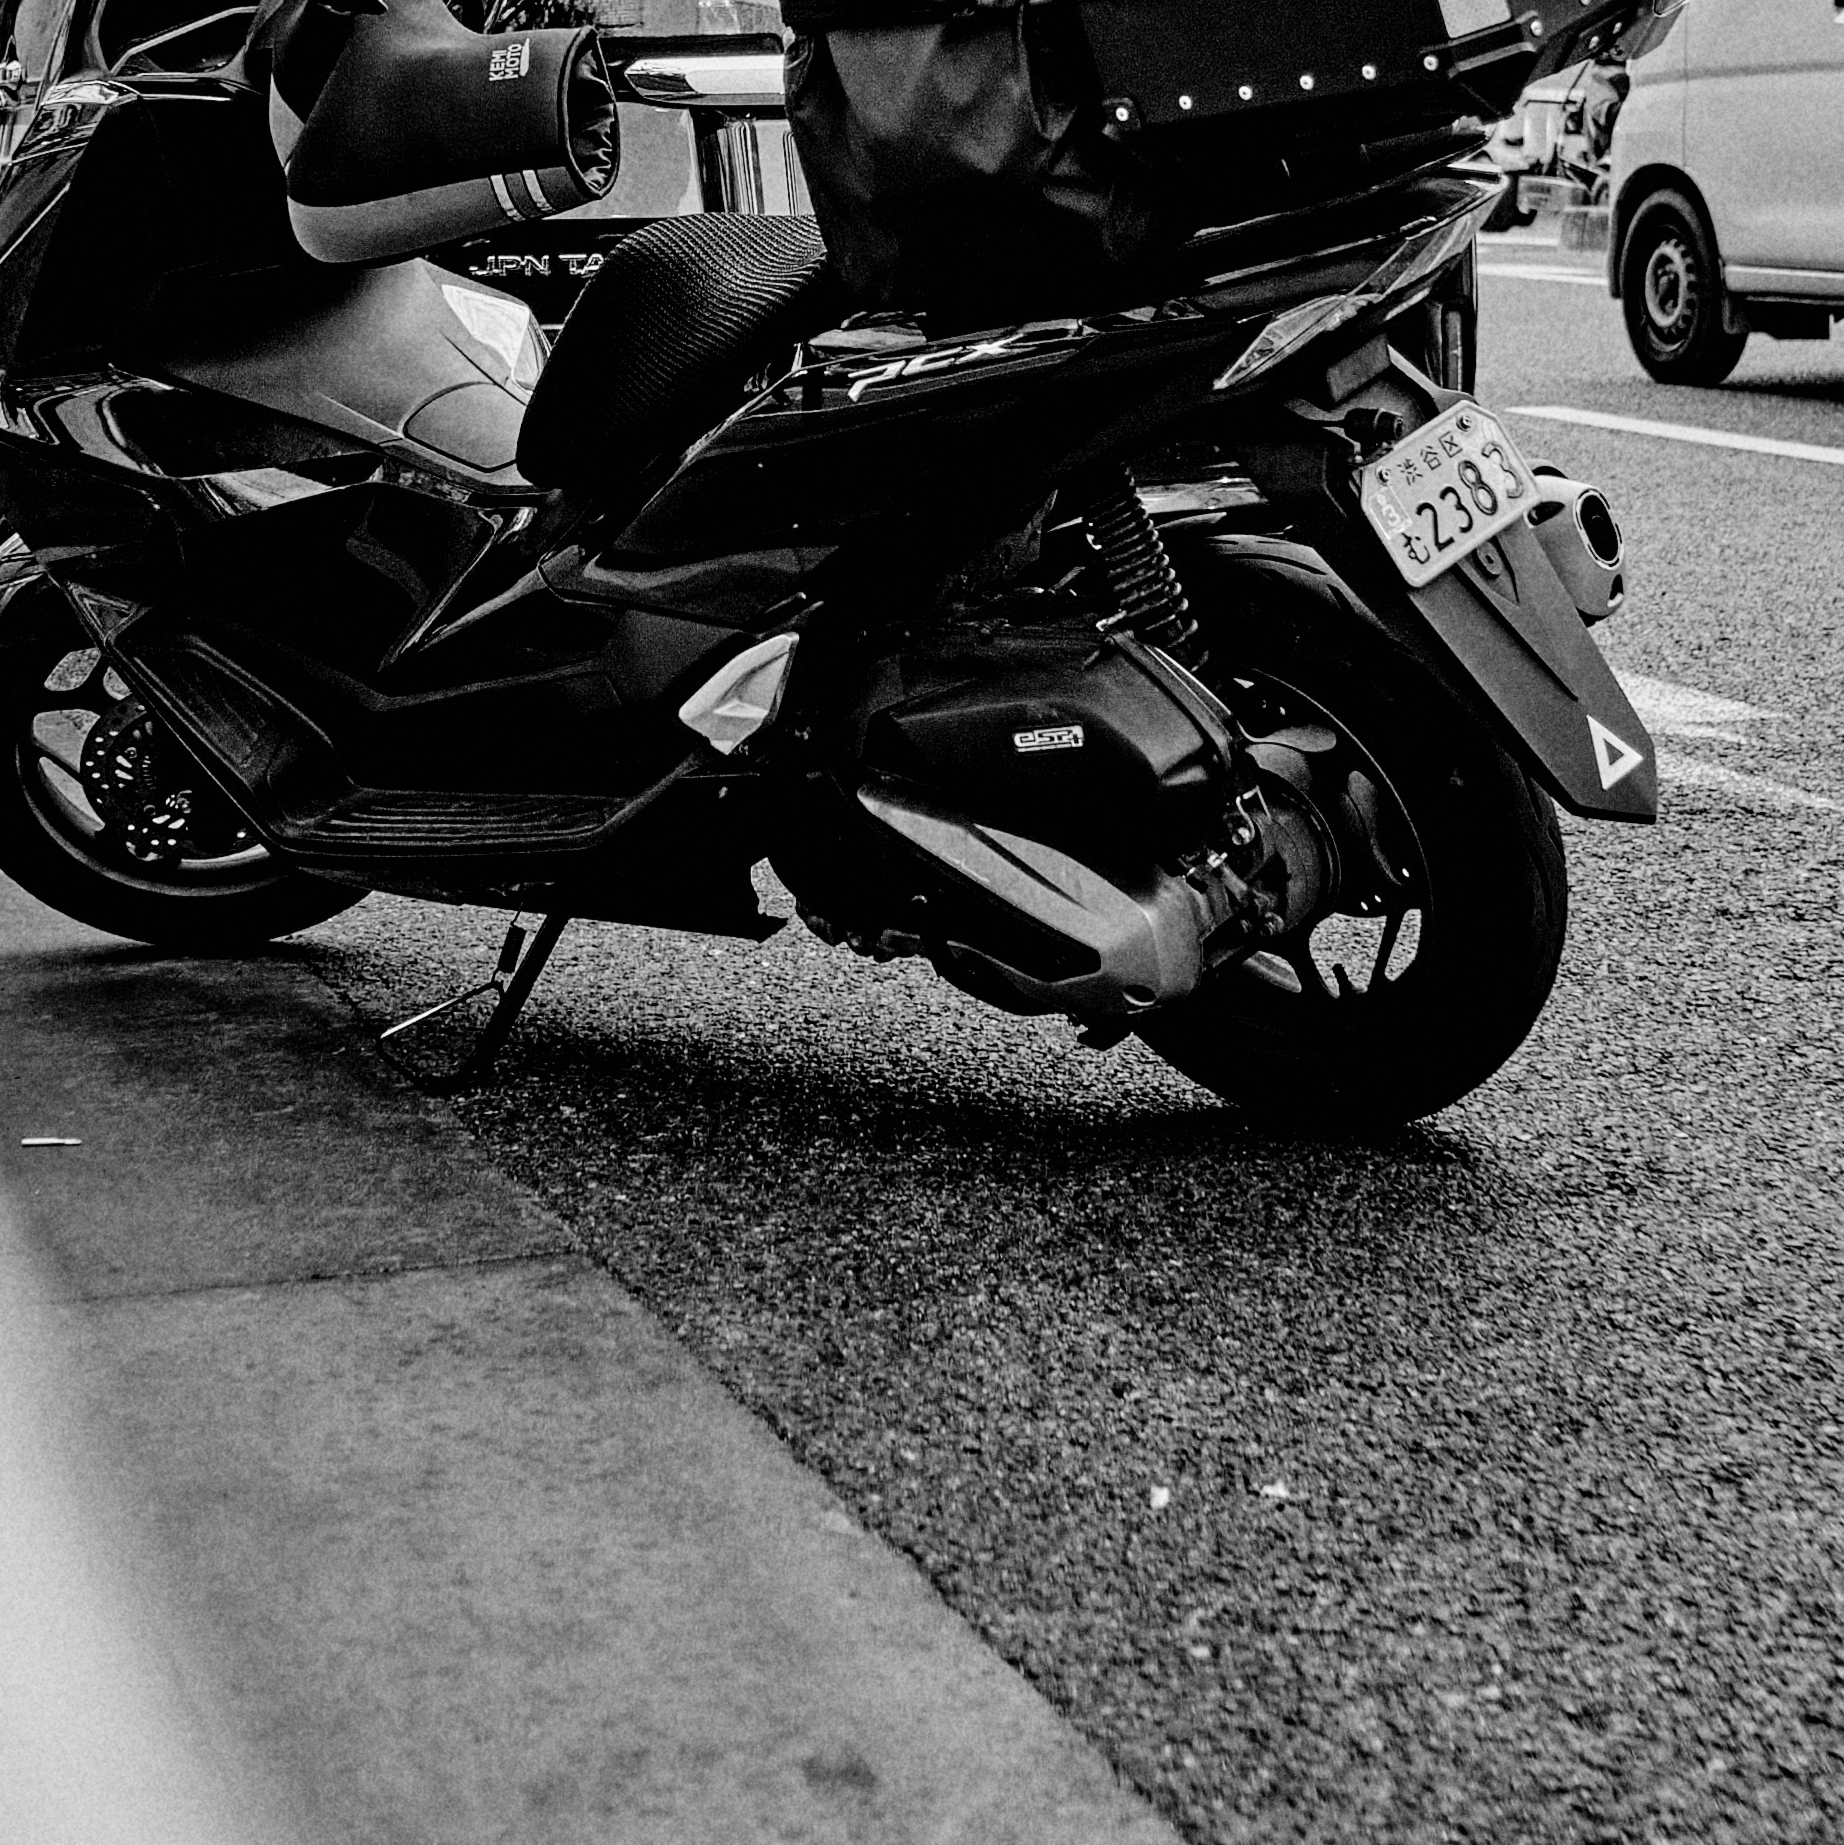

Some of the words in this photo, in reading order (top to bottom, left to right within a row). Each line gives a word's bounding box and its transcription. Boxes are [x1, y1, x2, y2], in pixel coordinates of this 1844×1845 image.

[488, 49, 508, 82] KEMI
[503, 43, 523, 80] MOTO
[468, 254, 552, 277] JPN
[557, 252, 605, 279] TA
[1395, 430, 1464, 487] 渋谷区
[1415, 440, 1524, 553] 2383
[1400, 531, 1431, 565] む
